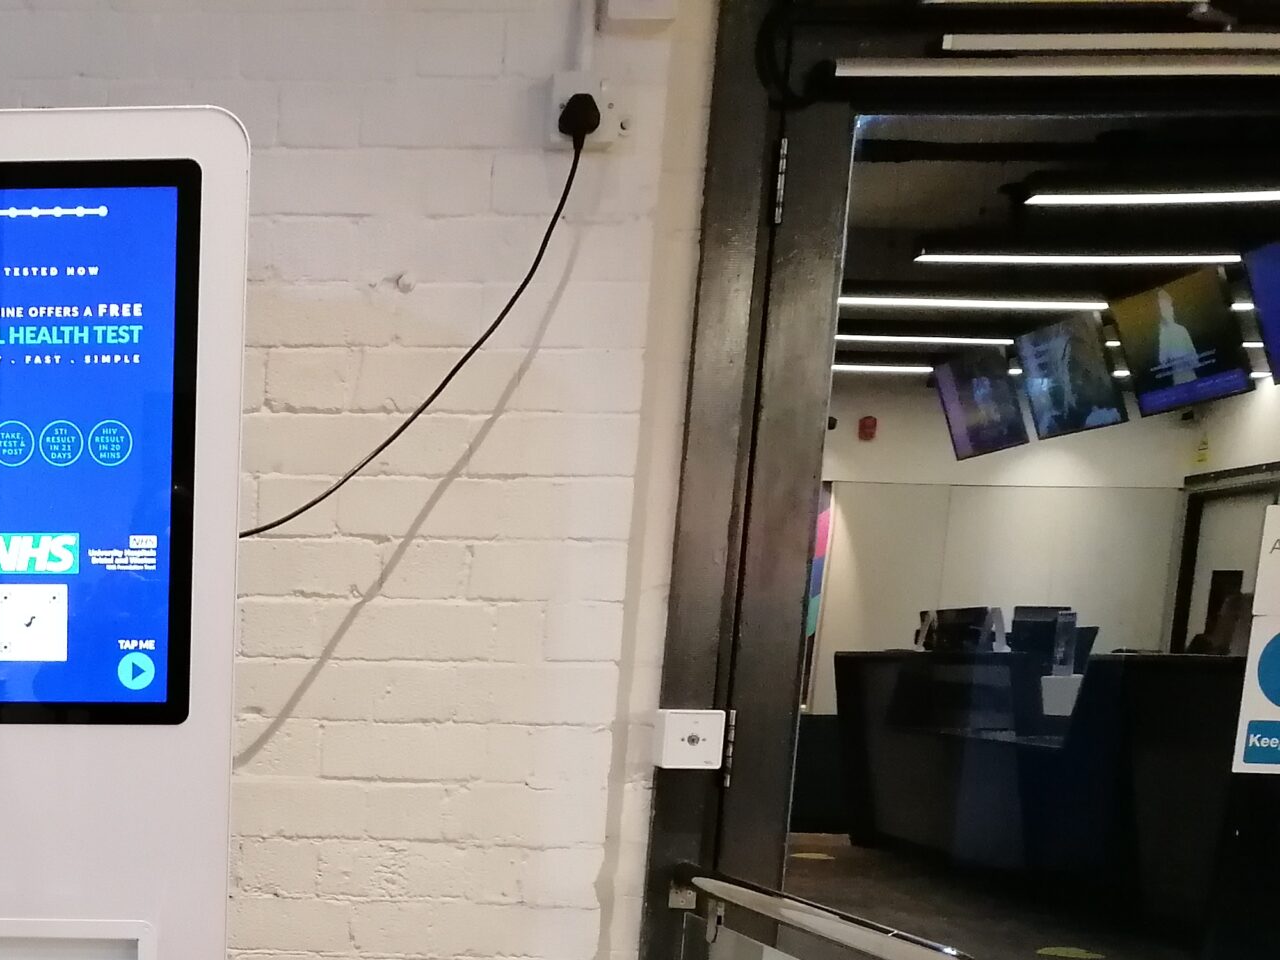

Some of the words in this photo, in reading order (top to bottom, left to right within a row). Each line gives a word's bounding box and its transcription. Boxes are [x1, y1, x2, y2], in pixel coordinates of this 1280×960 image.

[4, 266, 58, 276] TESTED
[67, 265, 99, 276] NOW
[29, 306, 79, 317] OFFERS
[83, 307, 93, 317] A
[98, 304, 143, 317] FREE
[9, 326, 89, 344] HEALTH
[94, 325, 143, 344] TEST
[25, 354, 61, 364] FAST
[85, 354, 141, 364] SIMPLE
[102, 427, 118, 435] HIV
[118, 640, 138, 650] TAP
[138, 640, 155, 650] ME
[1248, 733, 1280, 751] Kee
